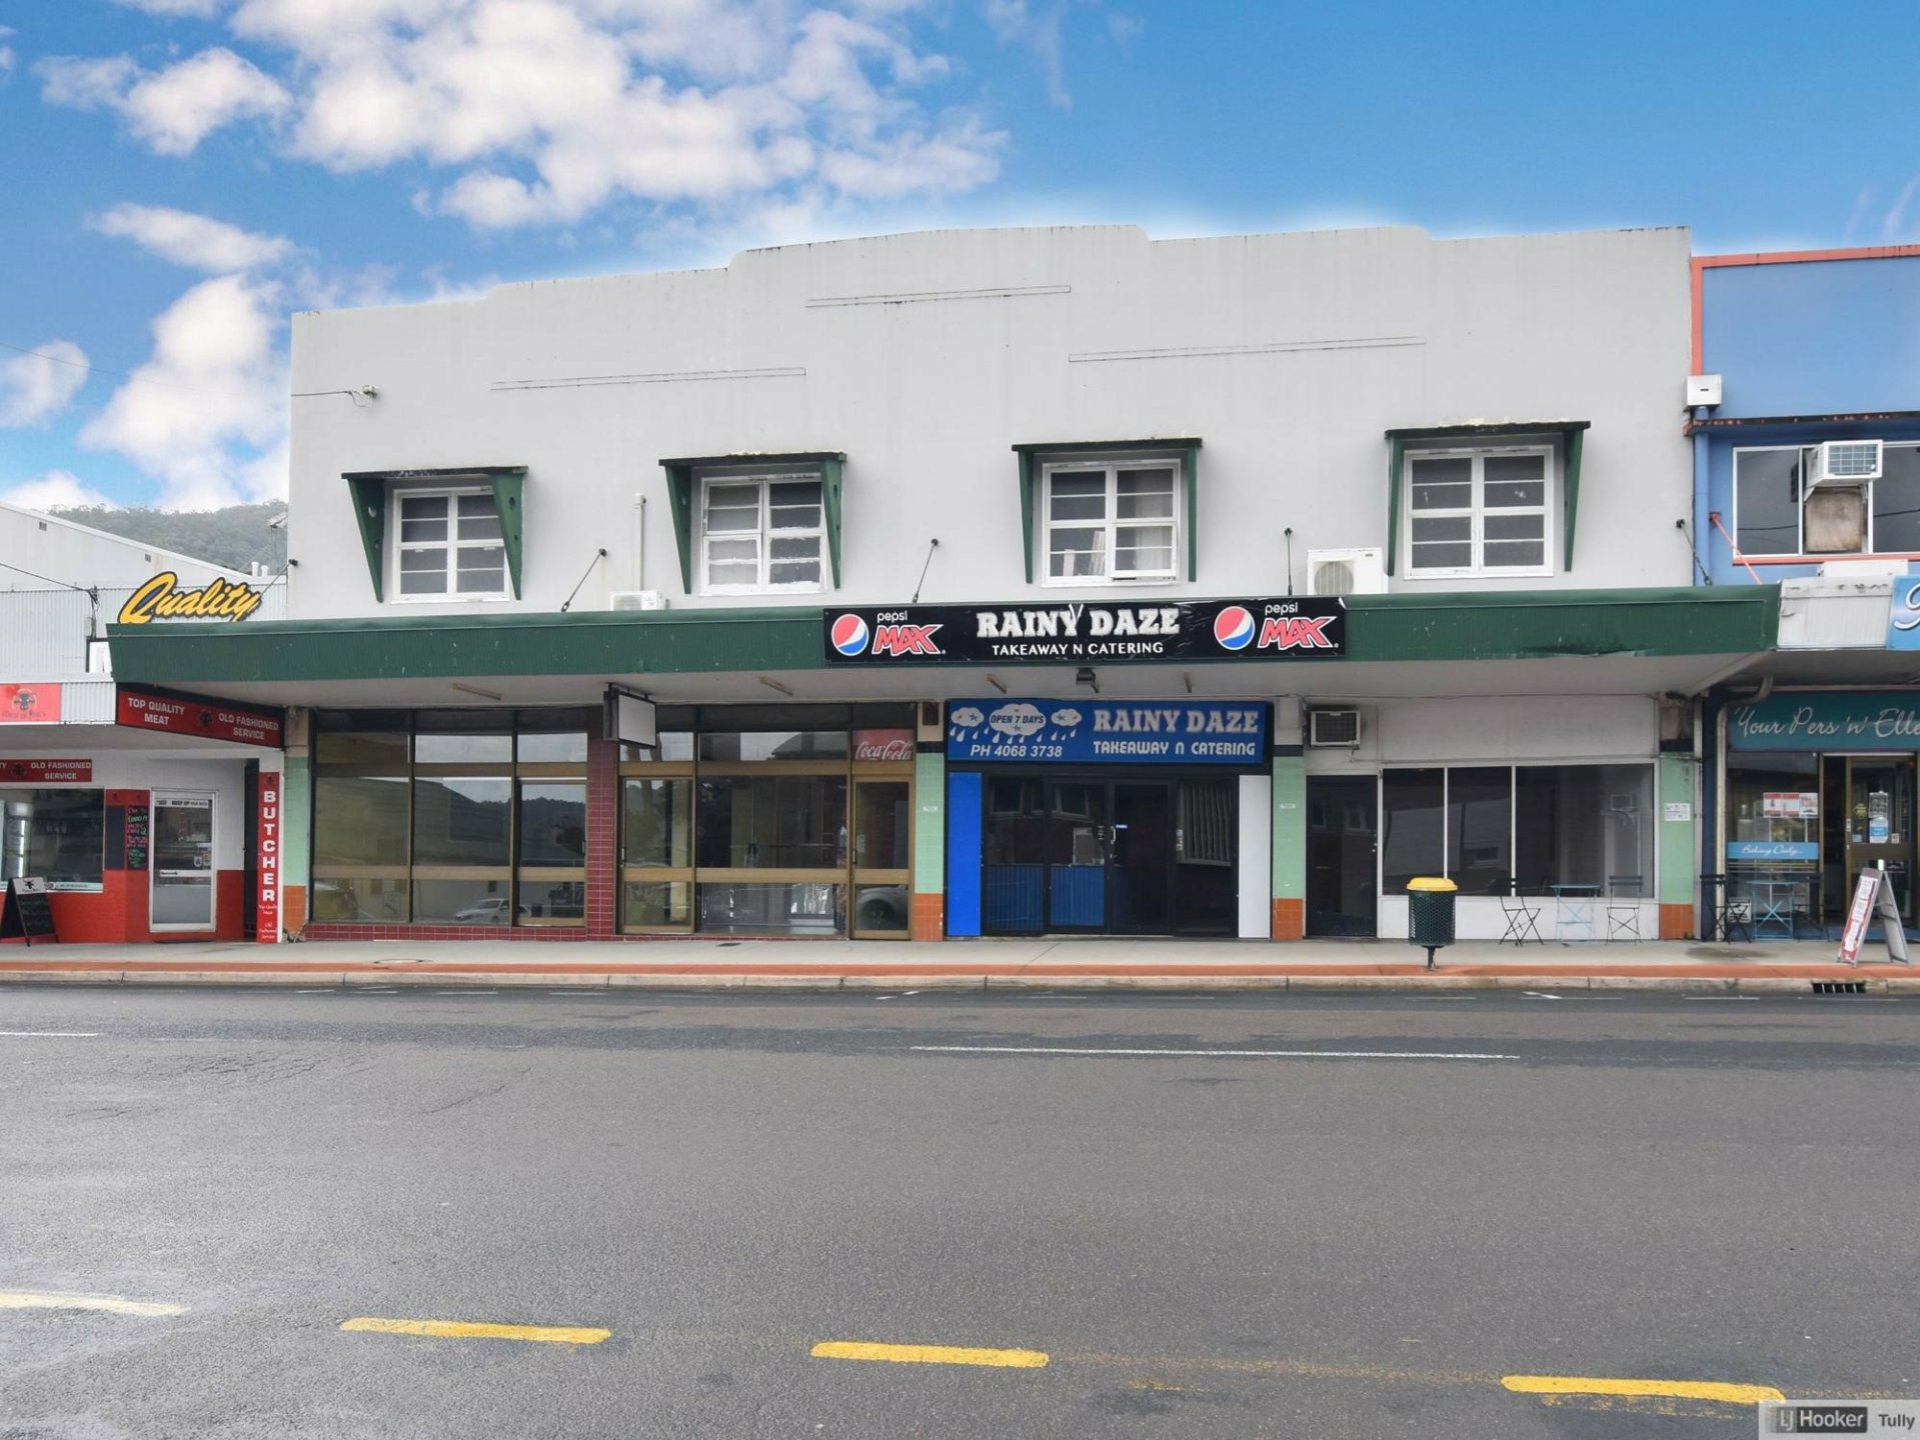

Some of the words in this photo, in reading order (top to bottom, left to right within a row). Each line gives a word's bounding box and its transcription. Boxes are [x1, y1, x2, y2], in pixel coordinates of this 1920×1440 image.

[118, 571, 262, 623] Quality
[877, 610, 908, 623] pepsi
[1265, 602, 1298, 615] pepsi
[976, 610, 1078, 637] RAINY
[1089, 608, 1180, 636] DAZE
[871, 624, 944, 656] MAX
[1257, 616, 1337, 650] MAX
[992, 643, 1068, 656] TAKEAWAY
[1073, 644, 1082, 655] N
[1088, 642, 1164, 655] CATERING
[127, 697, 146, 709] TOP
[148, 701, 185, 715] QUALITY
[144, 713, 169, 725] MEAT
[218, 712, 235, 724] OLD
[236, 716, 279, 730] FASHIONED
[990, 715, 1012, 724] OPEN
[1014, 715, 1021, 724] 7
[1022, 715, 1044, 724] DAYS
[1093, 709, 1180, 732] RAINY
[1186, 710, 1259, 733] DAZE
[1734, 706, 1785, 737] Your
[1789, 707, 1840, 735] Pers
[233, 727, 265, 740] SERVICE
[970, 744, 991, 757] PH
[994, 745, 1026, 757] 4068
[1030, 746, 1063, 757] 3738
[1093, 741, 1169, 754] TAKEAWAY
[1191, 742, 1255, 755] CATERING
[45, 772, 77, 780] SERVICE
[262, 790, 276, 902] BUTCHER
